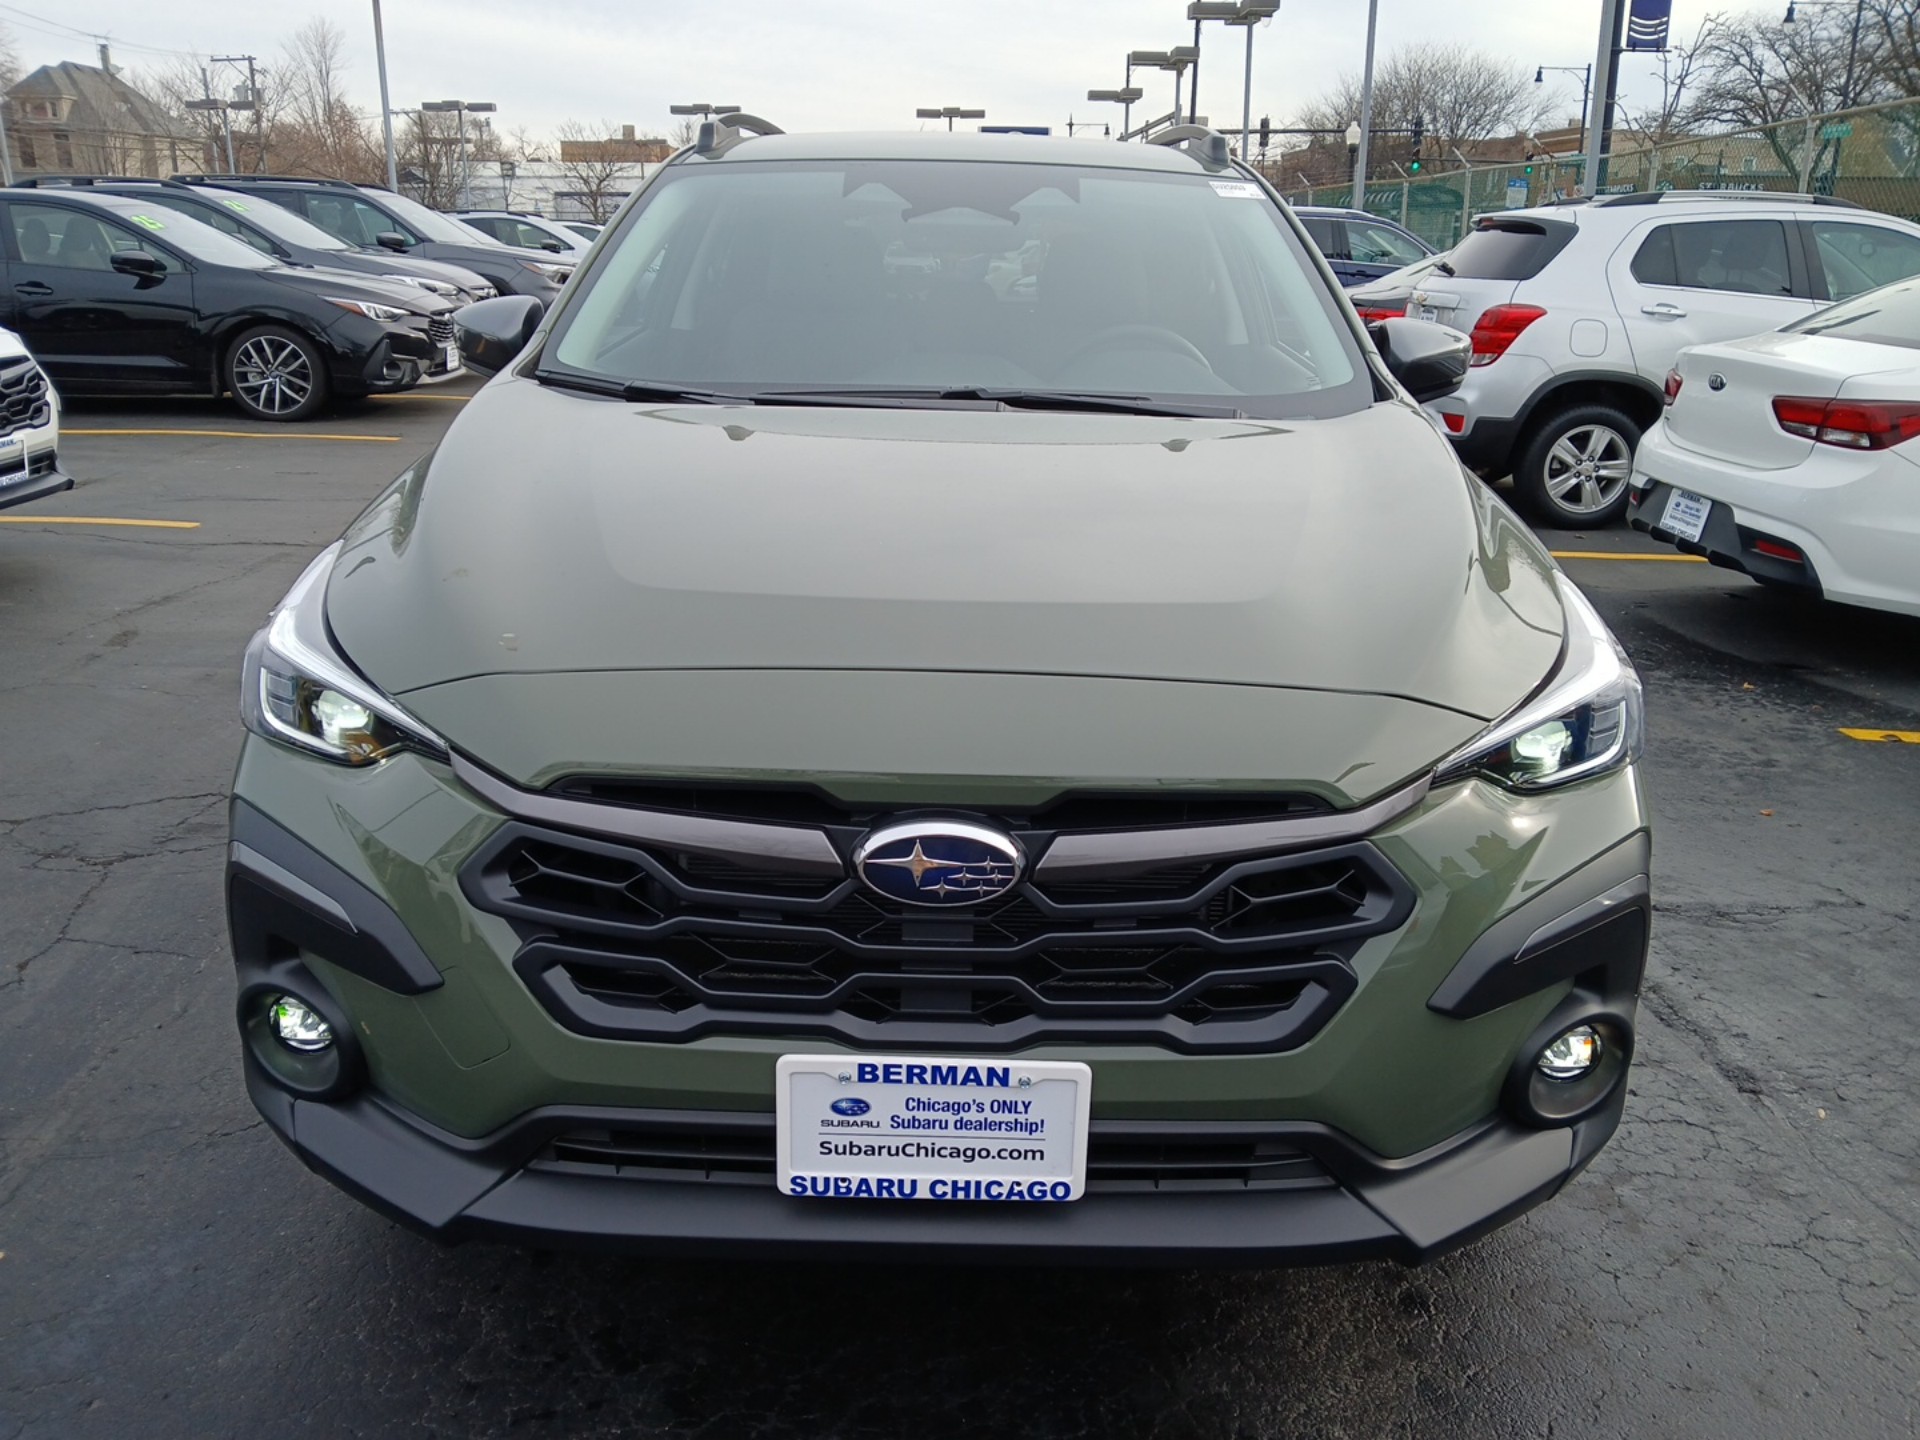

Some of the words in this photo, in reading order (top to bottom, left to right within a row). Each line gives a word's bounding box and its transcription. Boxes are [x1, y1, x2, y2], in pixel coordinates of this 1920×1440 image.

[1699, 182, 1765, 191] STRBUCKS
[857, 1063, 1010, 1088] BERMAN
[904, 1097, 985, 1116] Chicago’s
[990, 1099, 1033, 1115] ONLY
[820, 1119, 881, 1129] SUBARU
[889, 1114, 948, 1130] Subaru
[953, 1116, 1045, 1136] dealership!
[819, 1140, 1045, 1163] SubaruChicago.com
[790, 1175, 917, 1199] SUBARU
[929, 1179, 1071, 1201] CHICAGO
